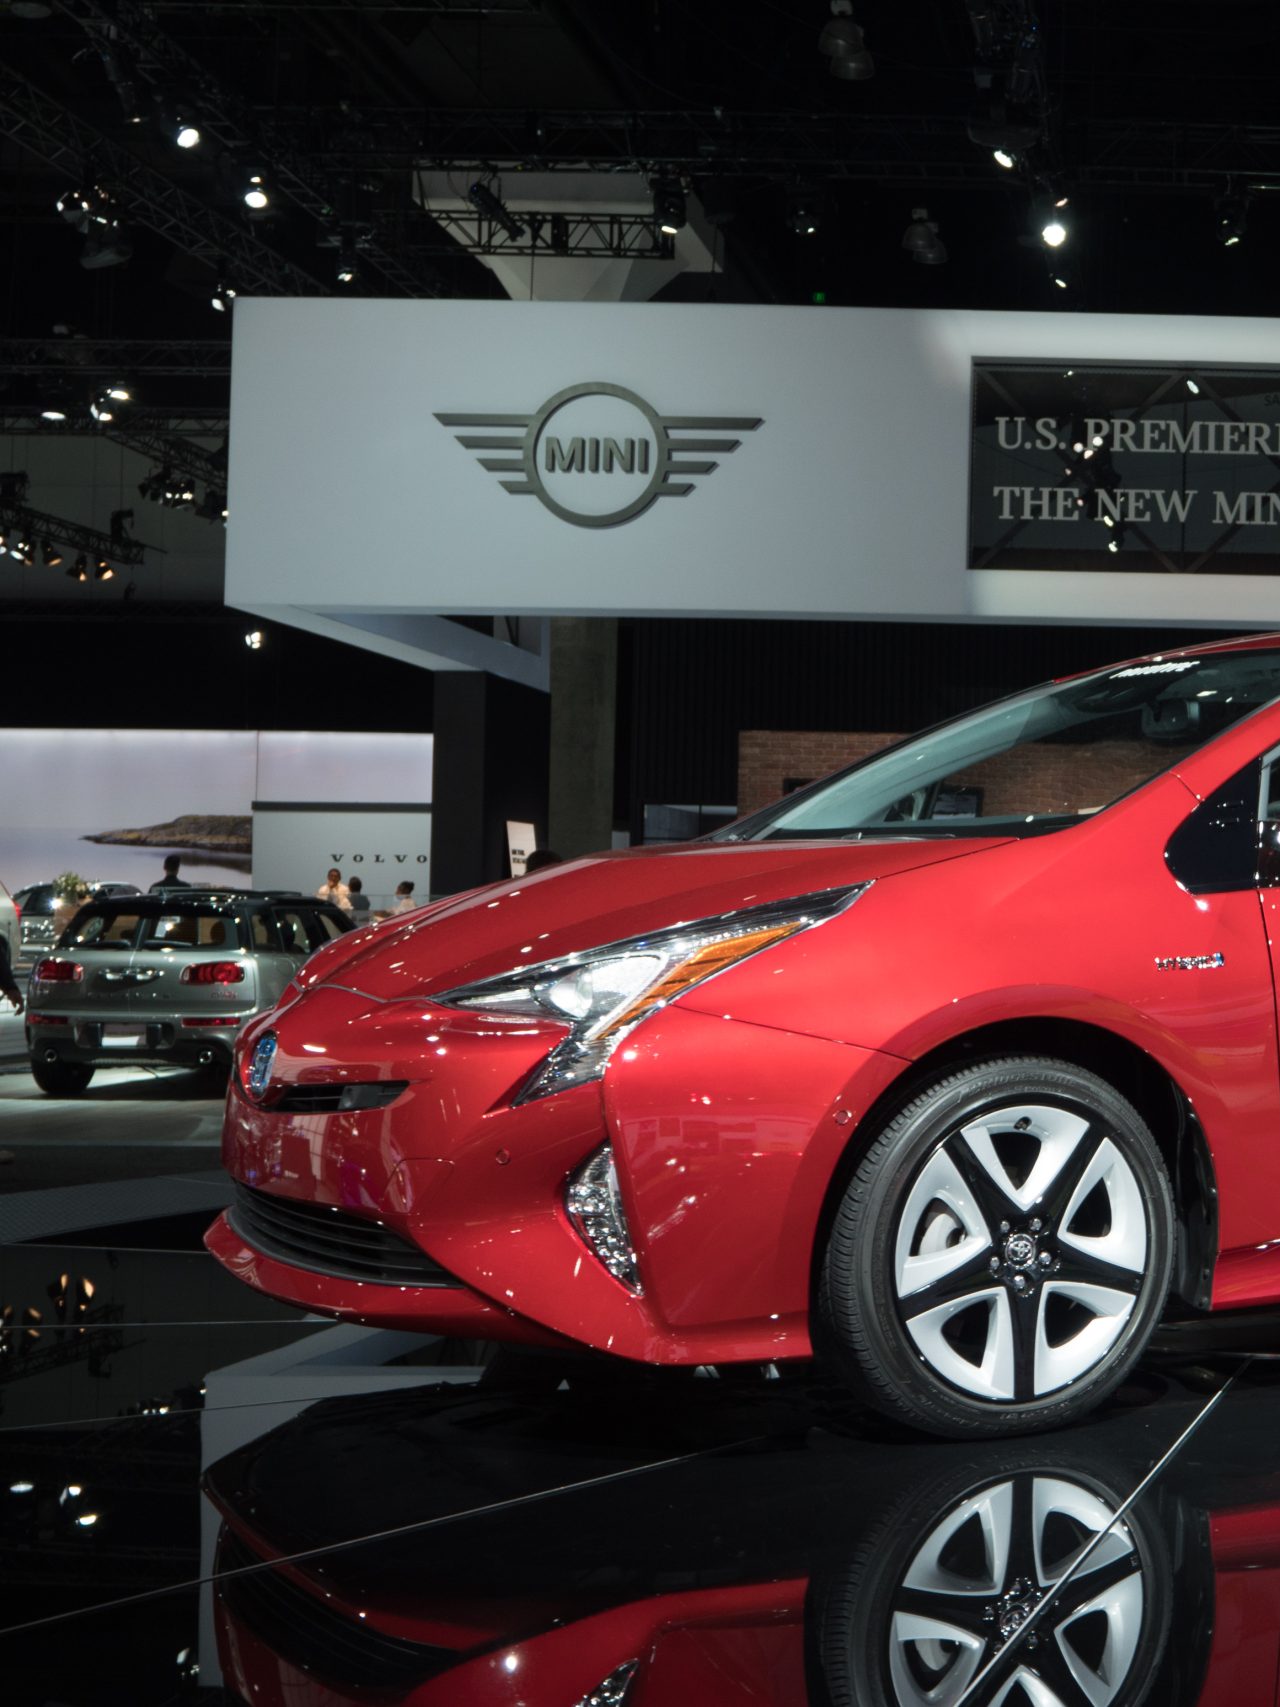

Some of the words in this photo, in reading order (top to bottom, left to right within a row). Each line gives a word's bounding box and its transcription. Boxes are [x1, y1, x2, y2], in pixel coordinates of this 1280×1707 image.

[996, 416, 1066, 450] U.S.
[545, 436, 650, 474] MINI
[993, 486, 1080, 522] THE
[1094, 488, 1197, 524] NEW
[331, 853, 428, 863] VOLVO
